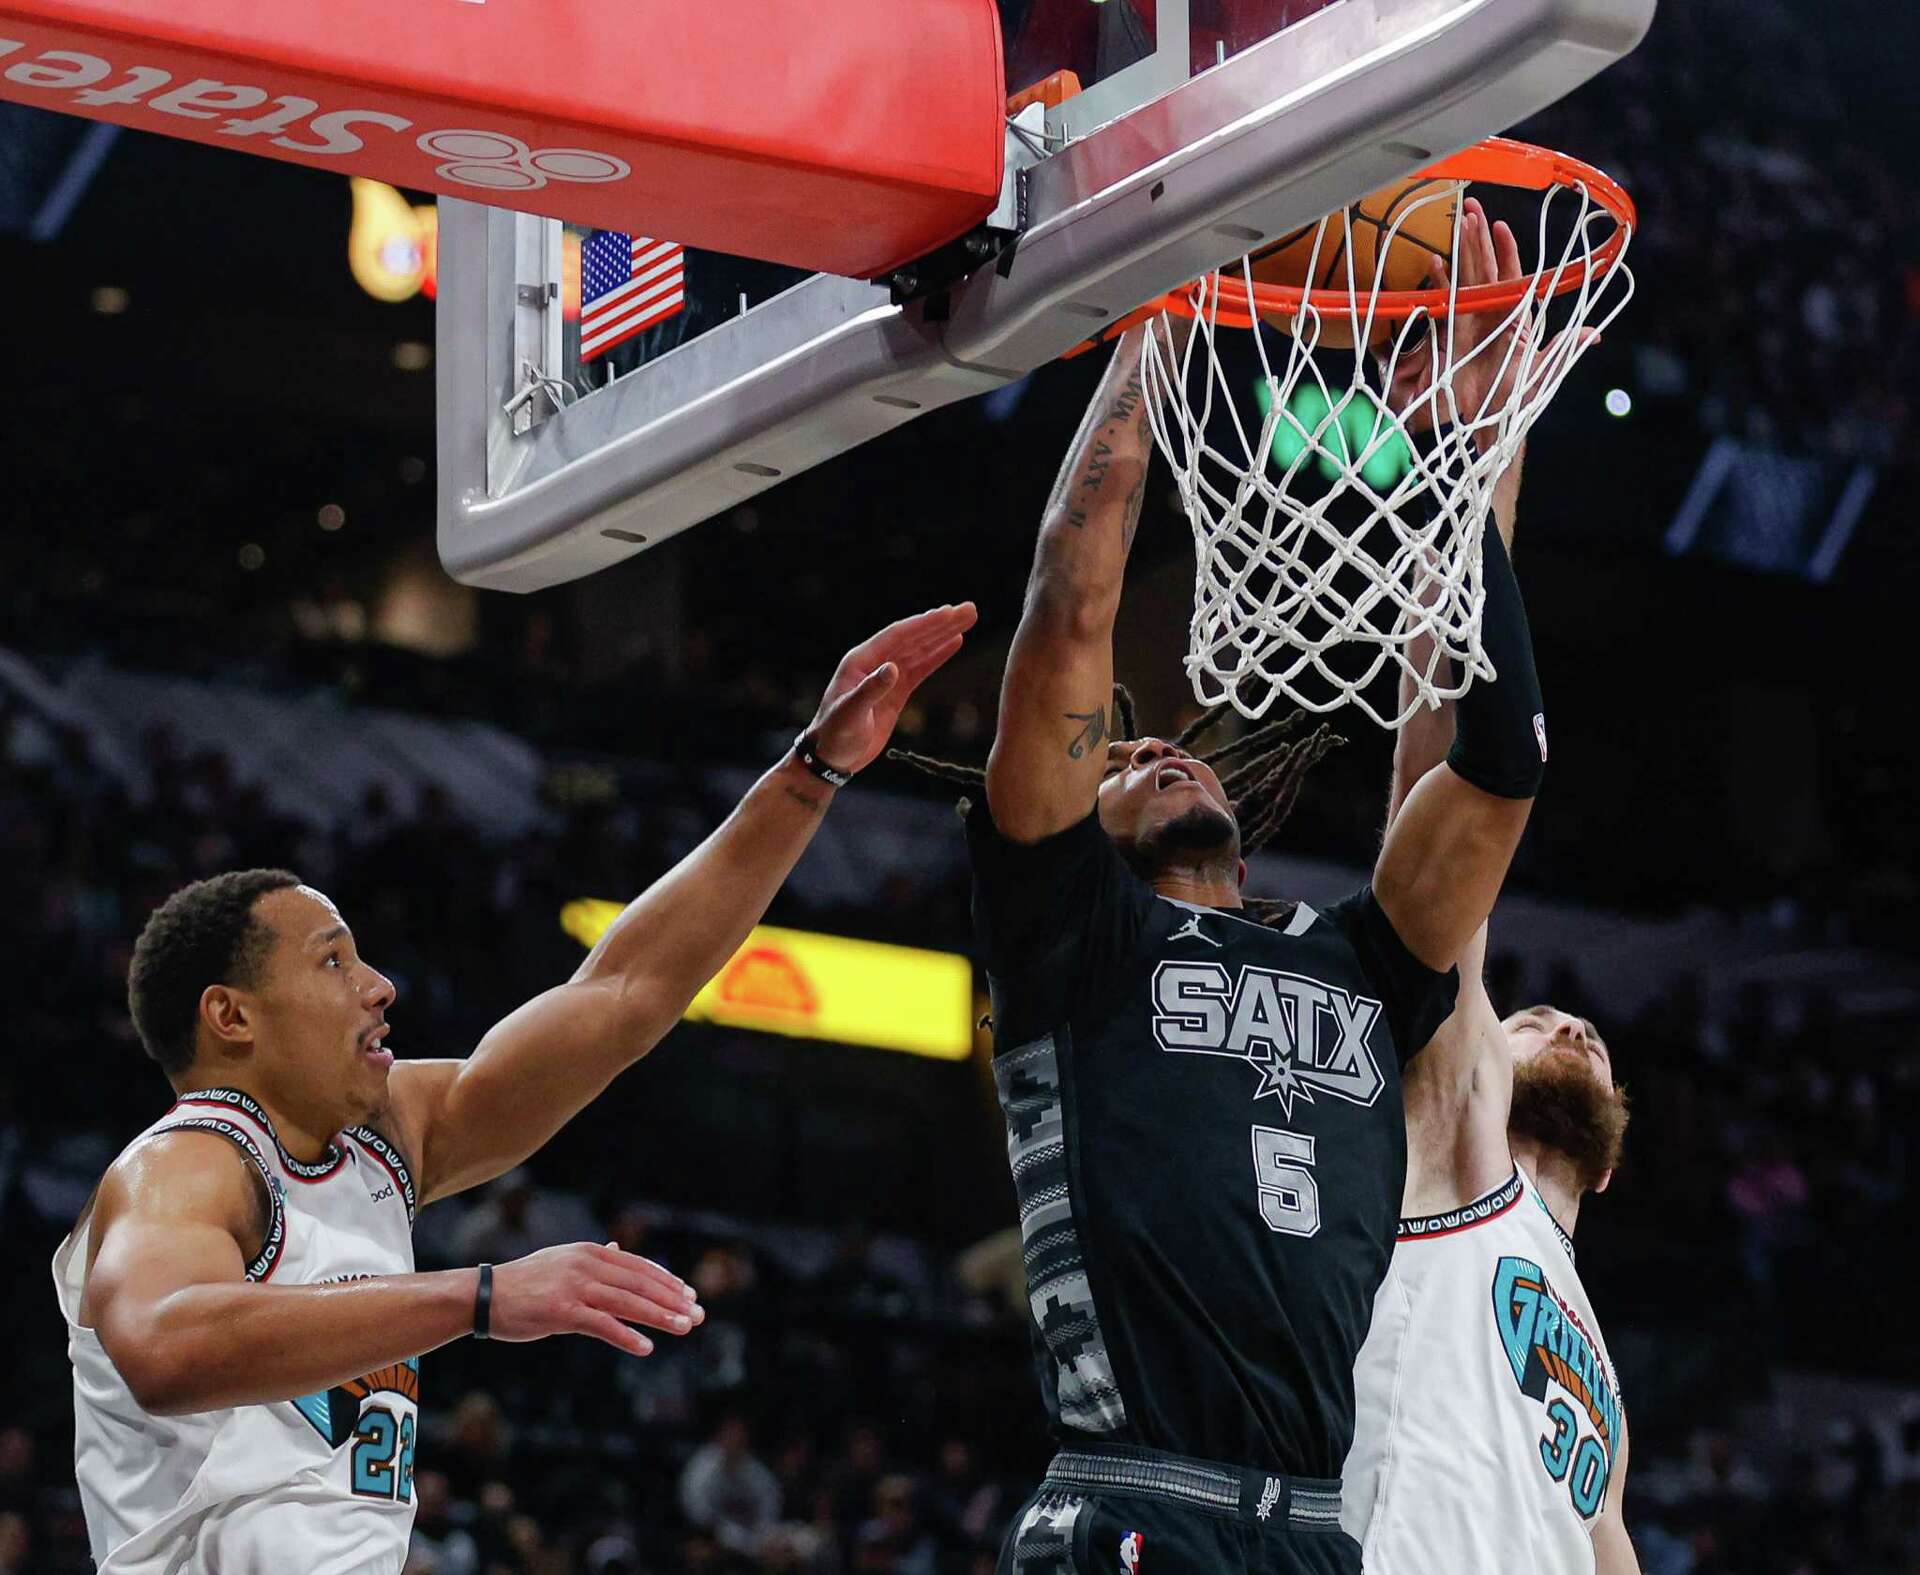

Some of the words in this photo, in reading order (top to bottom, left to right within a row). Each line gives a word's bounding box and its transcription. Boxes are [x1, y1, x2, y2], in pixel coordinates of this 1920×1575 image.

[4, 50, 413, 155] State
[1152, 959, 1386, 1107] SATX
[1251, 1124, 1321, 1238] 5
[1491, 1256, 1622, 1466] GRIZZL
[351, 1405, 415, 1504] 22
[1539, 1396, 1607, 1520] 30
